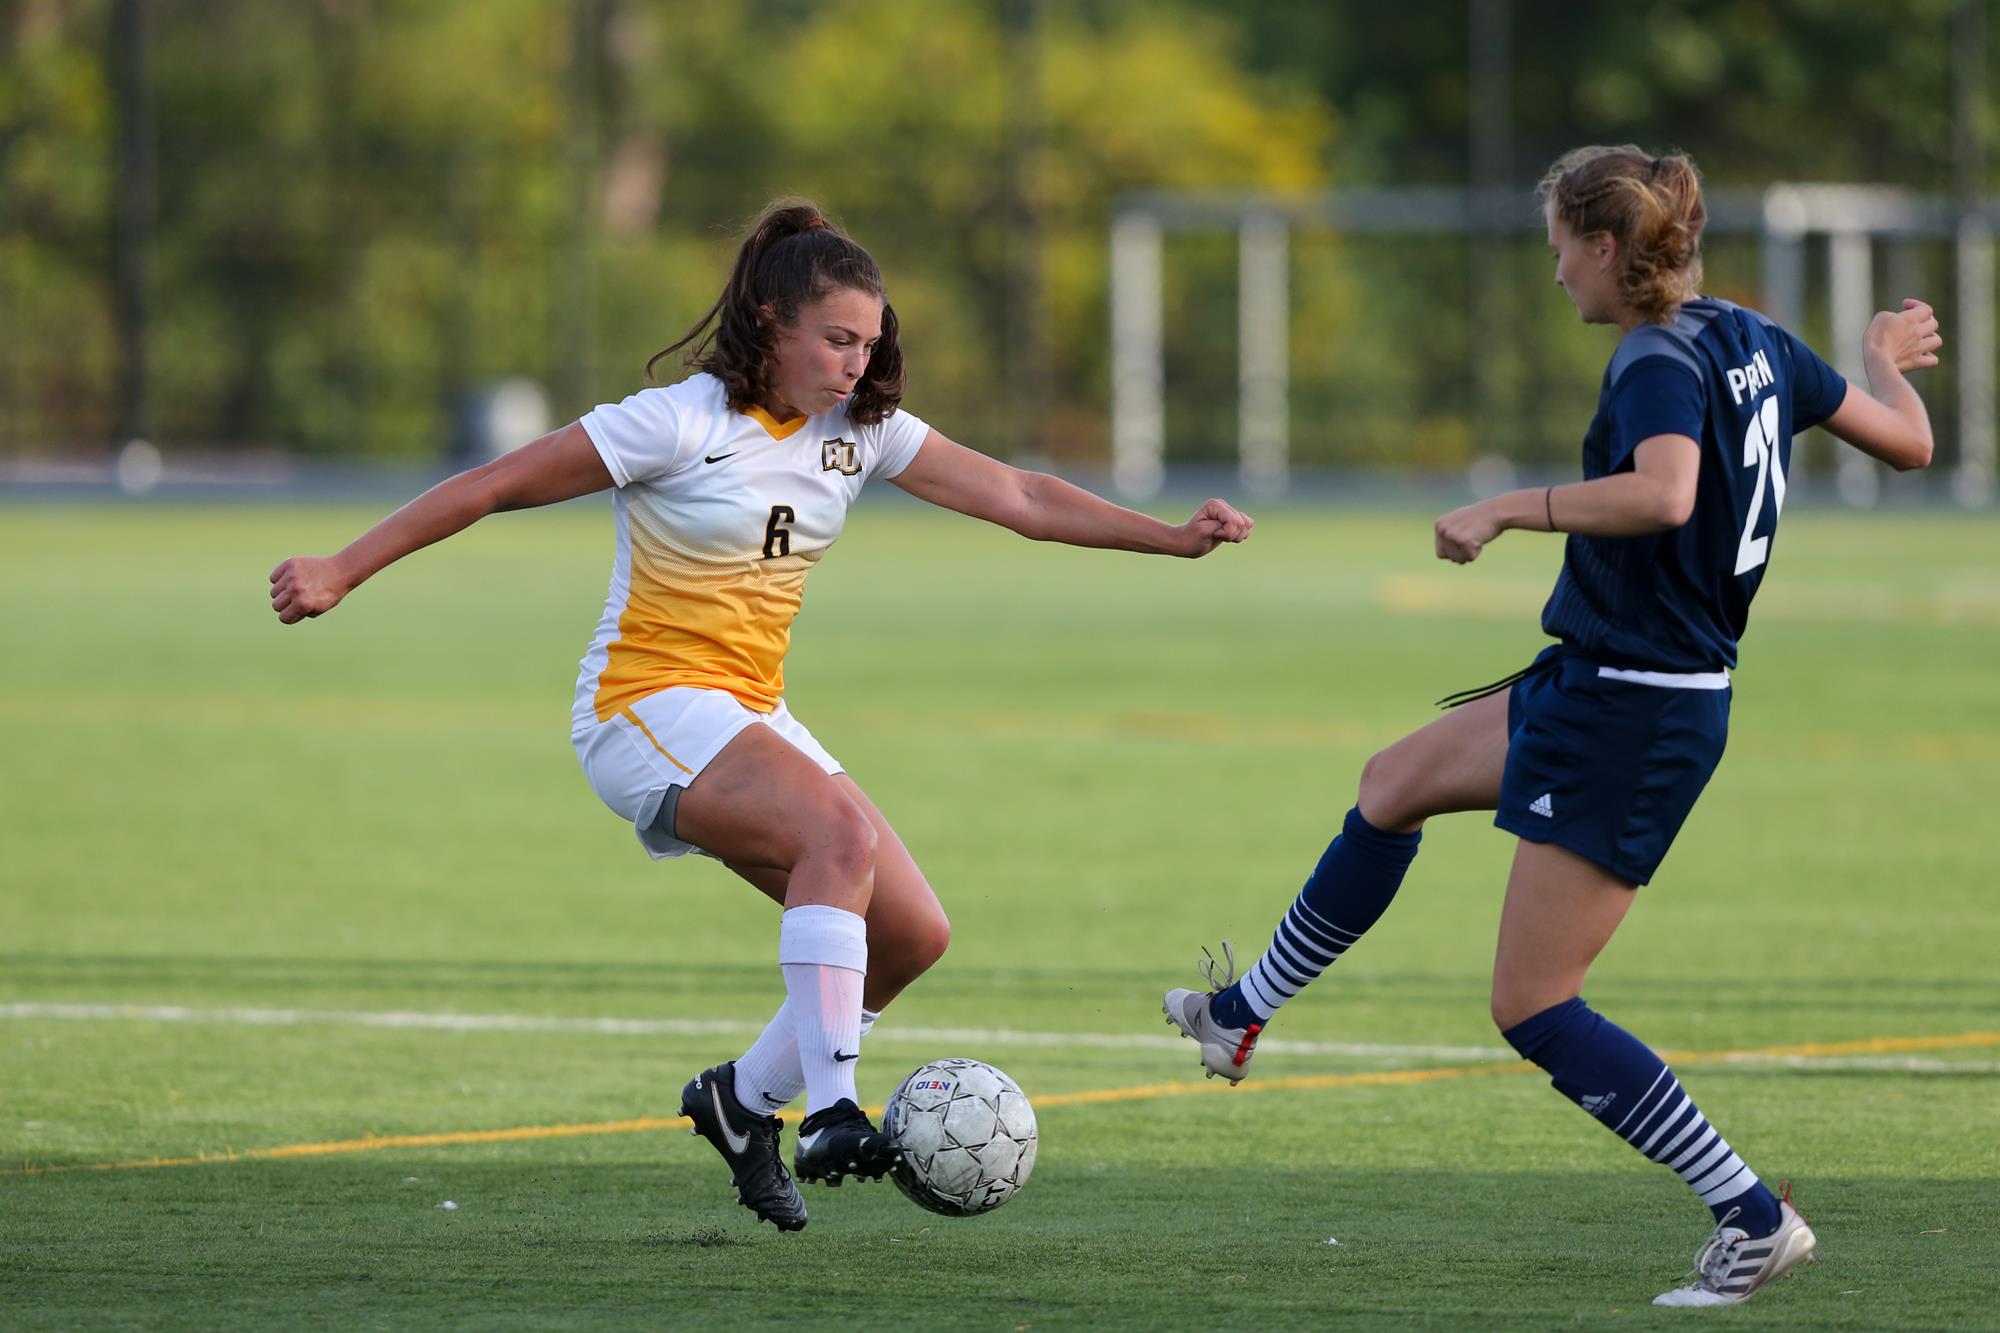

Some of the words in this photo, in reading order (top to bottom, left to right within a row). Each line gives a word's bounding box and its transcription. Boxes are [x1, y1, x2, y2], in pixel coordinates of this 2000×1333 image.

[823, 440, 861, 474] AU
[1734, 395, 1786, 576] 21
[763, 505, 795, 559] 6
